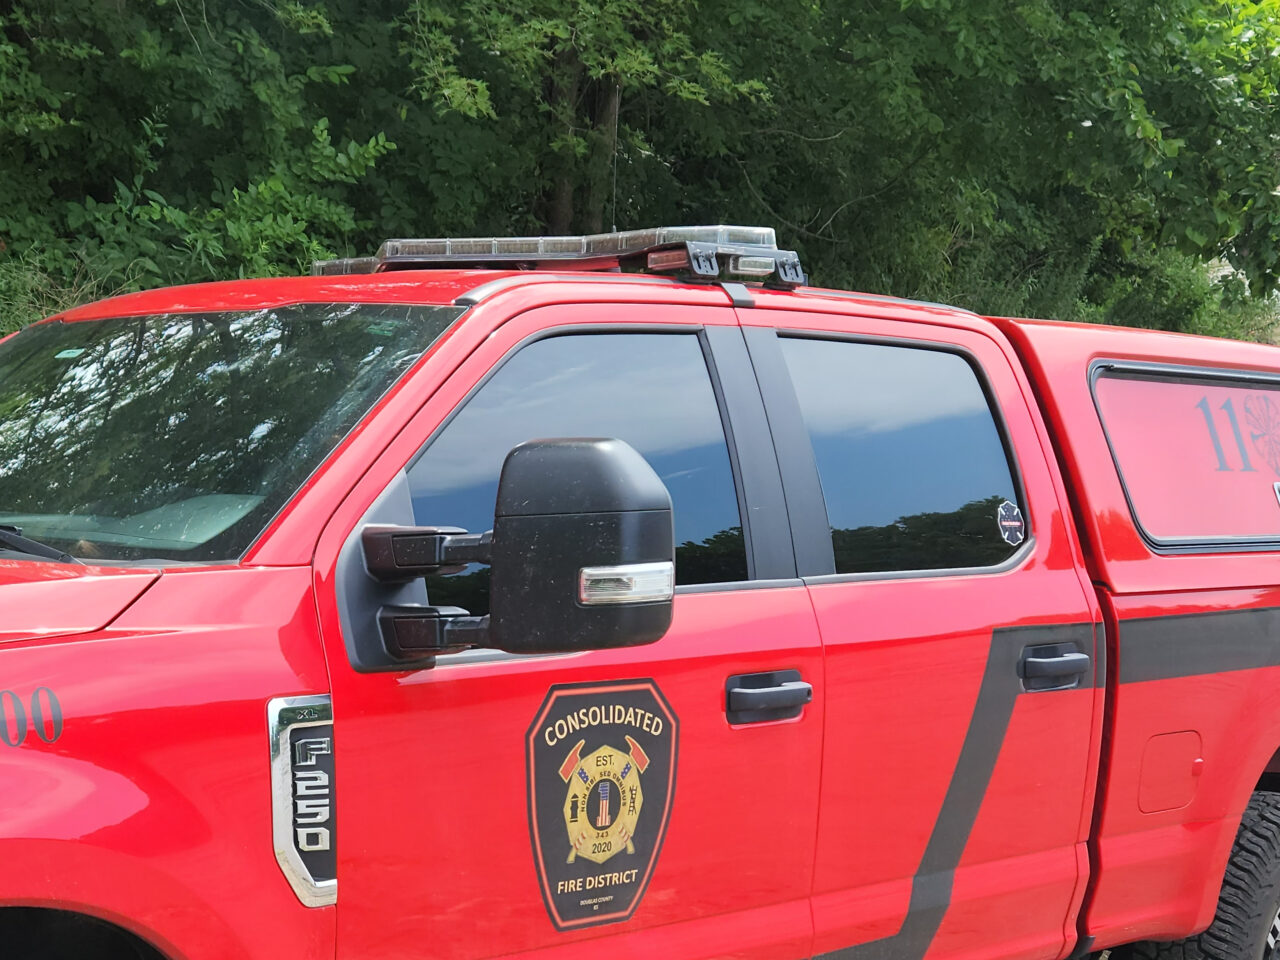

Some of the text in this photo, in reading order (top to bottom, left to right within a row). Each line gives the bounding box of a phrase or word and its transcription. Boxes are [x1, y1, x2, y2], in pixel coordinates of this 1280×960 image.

[1194, 395, 1258, 472] 11
[296, 708, 319, 720] XL
[544, 705, 664, 747] CONSOLIDATED
[596, 755, 615, 767] EST.
[600, 770, 612, 778] SED
[294, 737, 332, 852] F250
[592, 841, 612, 854] 2020
[557, 869, 638, 894] FIRE DISTRICT
